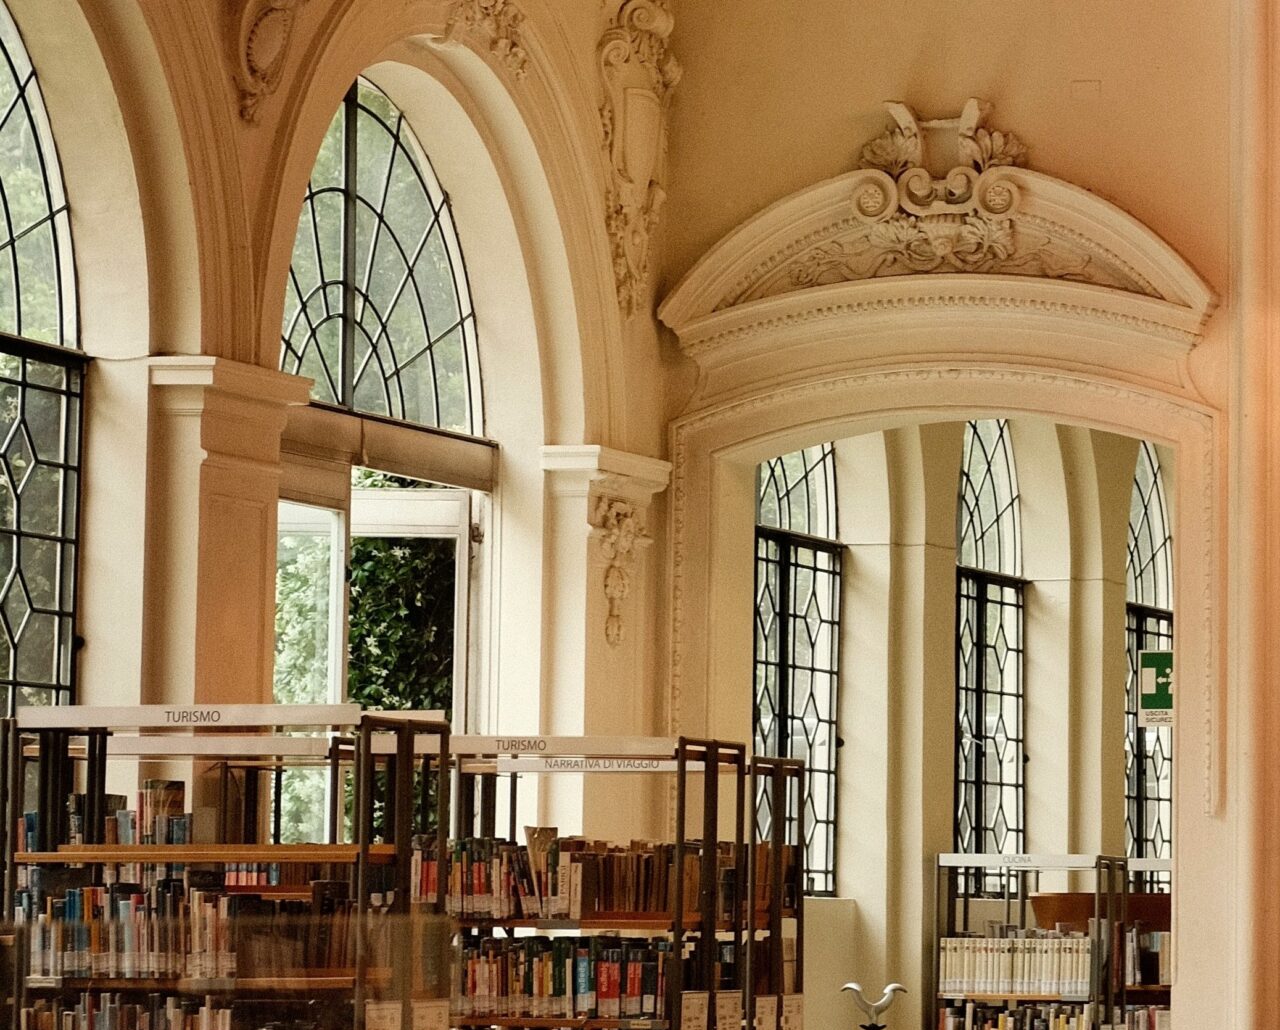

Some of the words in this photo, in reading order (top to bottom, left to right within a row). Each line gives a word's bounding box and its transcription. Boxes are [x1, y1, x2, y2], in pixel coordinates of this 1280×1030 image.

[164, 709, 221, 724] TURISMO
[496, 739, 547, 751] TURISMO
[544, 759, 601, 769] NARRATIVA
[603, 759, 614, 769] DI
[616, 759, 660, 769] VIAGGIO
[1002, 855, 1032, 864] CUCINA
[578, 961, 587, 993] Spagna
